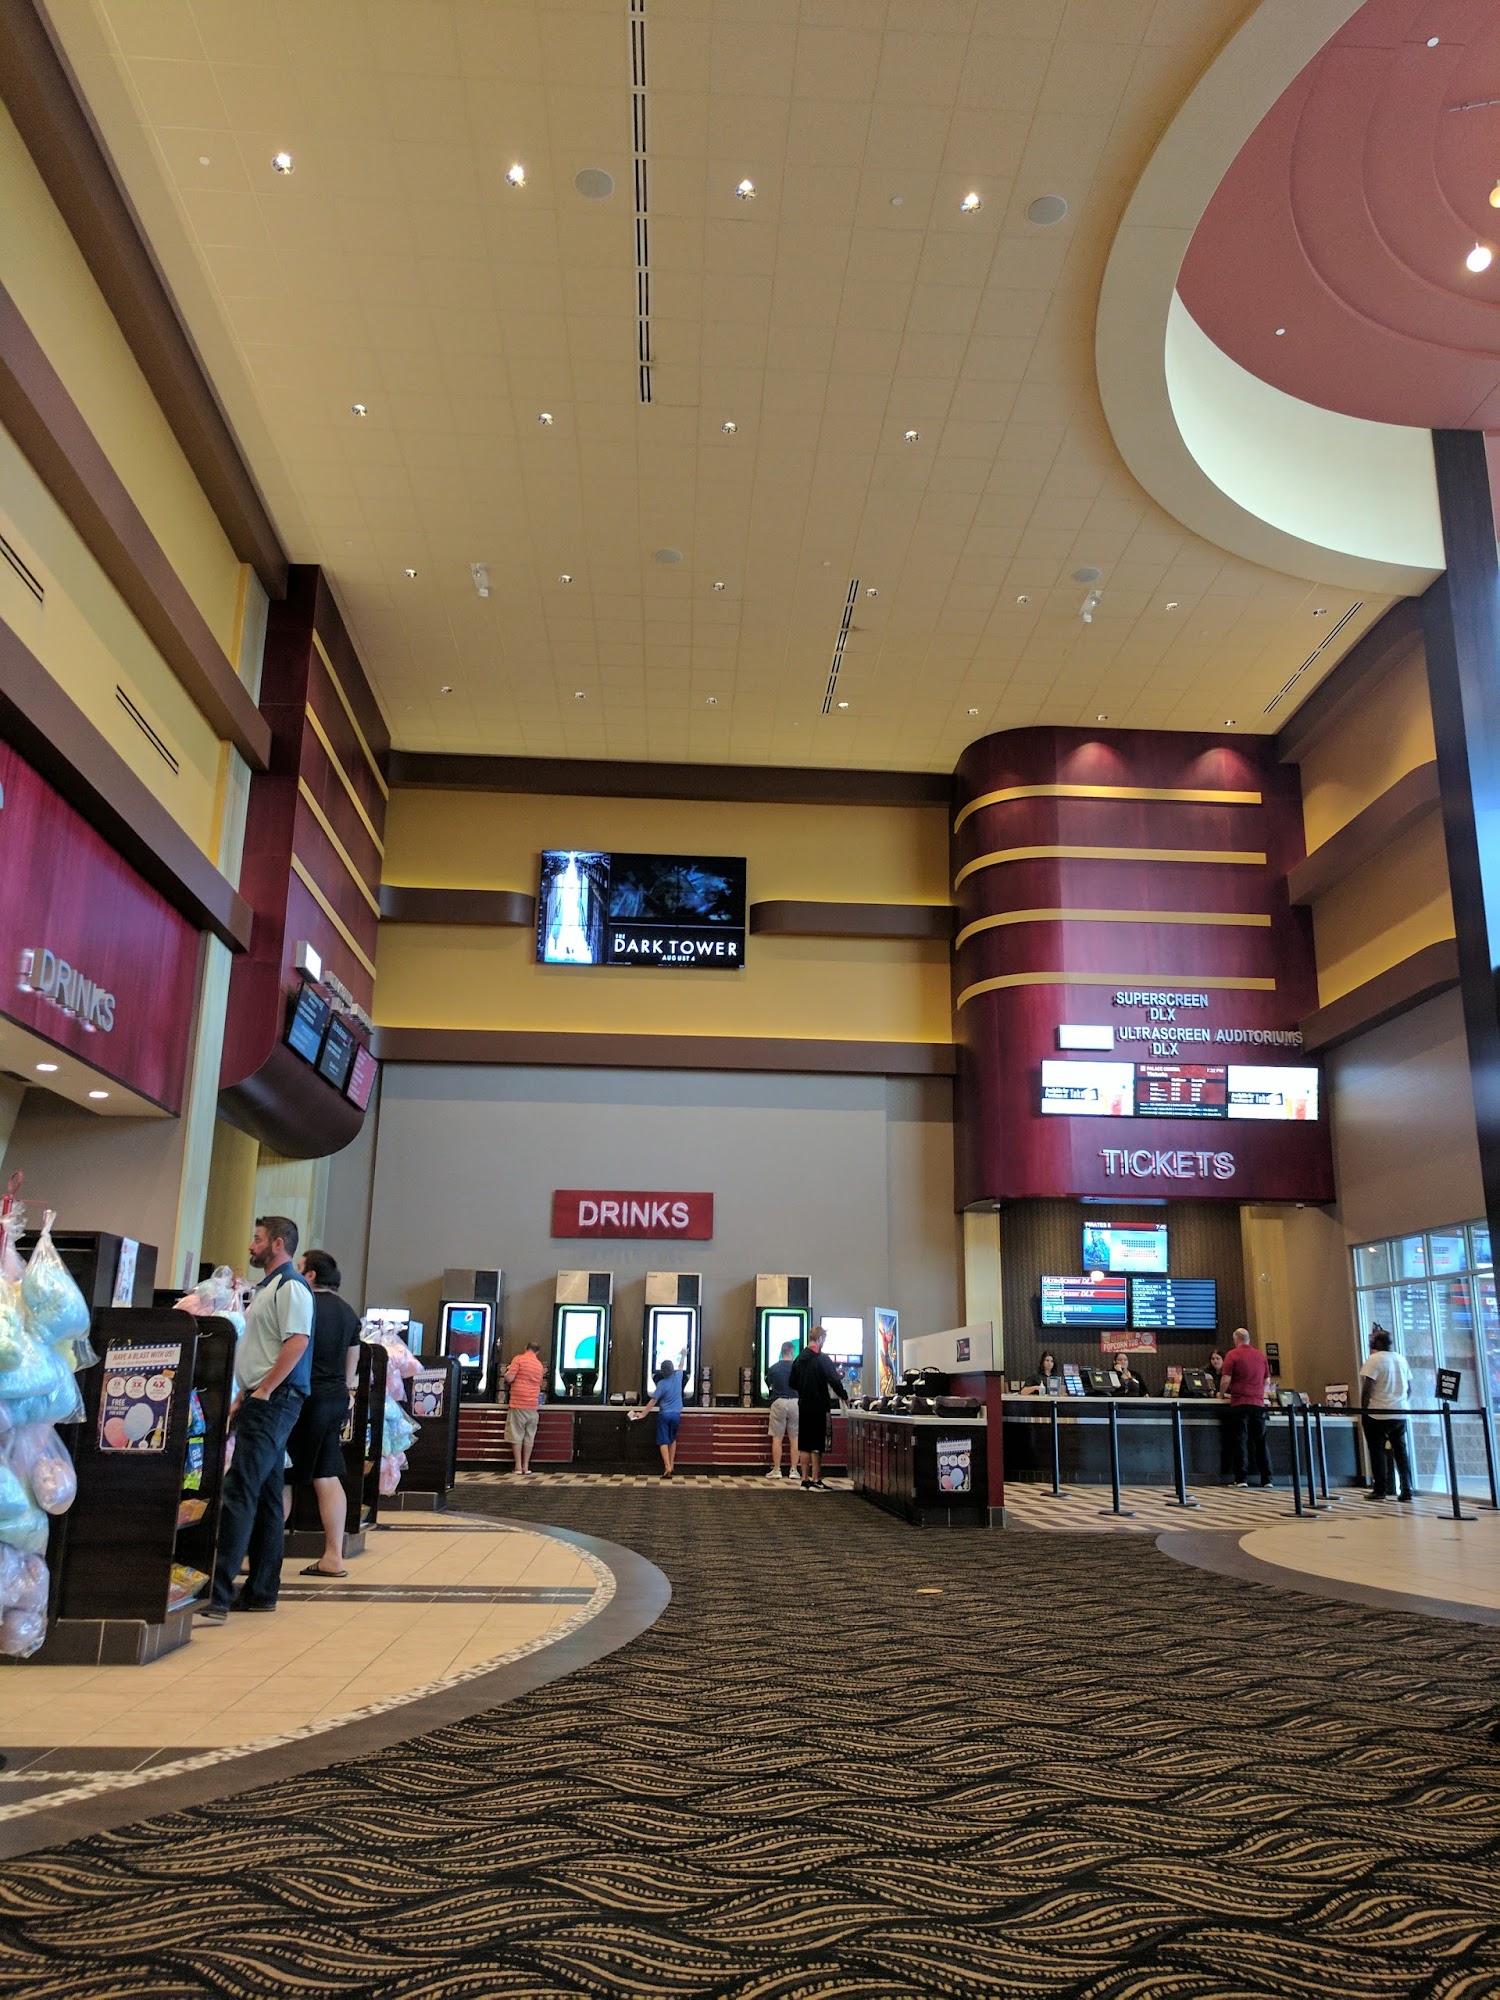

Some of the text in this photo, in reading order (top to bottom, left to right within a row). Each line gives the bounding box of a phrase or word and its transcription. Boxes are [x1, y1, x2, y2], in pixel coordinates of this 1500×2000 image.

[614, 939, 737, 956] DARK TOWER
[32, 949, 116, 1032] DRINKS
[1116, 991, 1209, 1007] SUPERSCREEN
[1150, 1007, 1176, 1021] DLX
[1119, 1026, 1303, 1044] ULTRASCREEN AUDITORIUMS
[1153, 1042, 1179, 1055] DLX
[1102, 1149, 1235, 1177] TICKETS
[578, 1200, 690, 1228] DRINKS
[1103, 1340, 1128, 1351] POPCORN
[113, 1352, 127, 1360] HAVE
[132, 1351, 150, 1360] BLAST
[150, 1351, 163, 1359] WITH
[164, 1350, 175, 1358] US!
[152, 1380, 166, 1388] 4X
[111, 1398, 126, 1406] FREE
